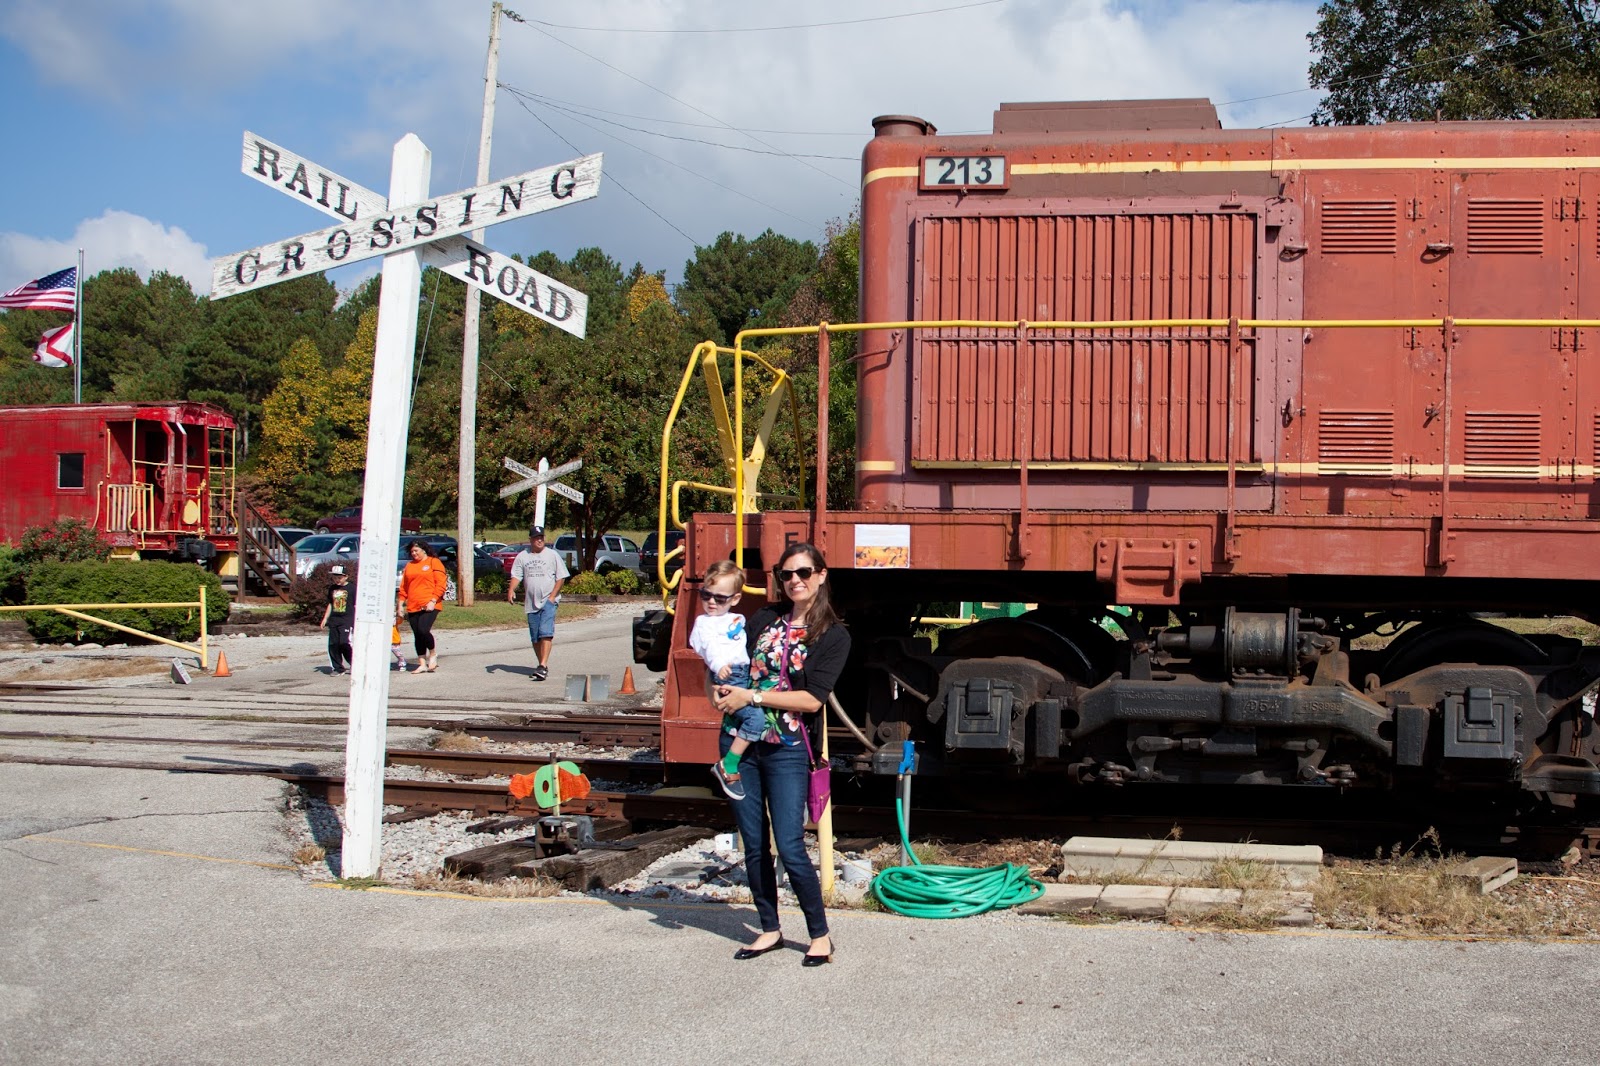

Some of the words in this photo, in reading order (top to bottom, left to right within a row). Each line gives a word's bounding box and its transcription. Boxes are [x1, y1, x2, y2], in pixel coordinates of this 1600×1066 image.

[235, 167, 576, 285] CROSSING
[937, 156, 992, 185] 213
[253, 140, 358, 220] RAIL
[464, 244, 573, 322] ROAD
